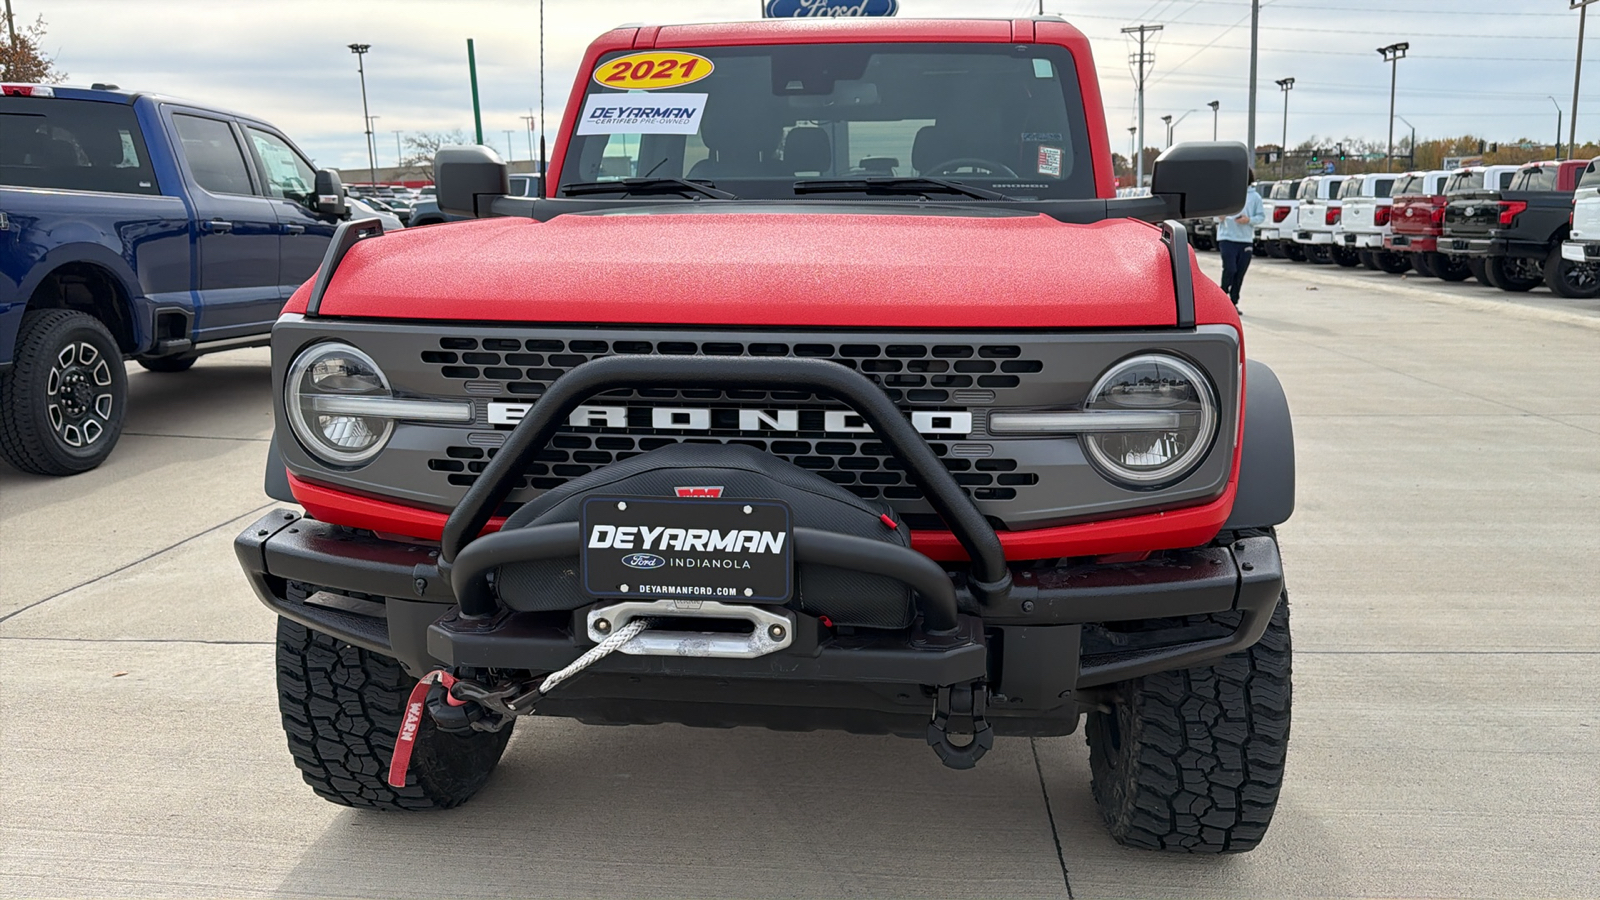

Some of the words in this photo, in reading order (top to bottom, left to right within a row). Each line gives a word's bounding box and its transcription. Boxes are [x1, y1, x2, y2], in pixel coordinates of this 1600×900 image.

[793, 0, 869, 18] Ford
[604, 58, 699, 82] 2021
[590, 107, 697, 118] DEYARMAN
[588, 524, 786, 554] DEYARMAN
[630, 555, 657, 567] Ford
[669, 557, 751, 569] INDIANOLA
[639, 584, 737, 596] DEYARMANFORD.COM
[401, 702, 422, 741] WARN
